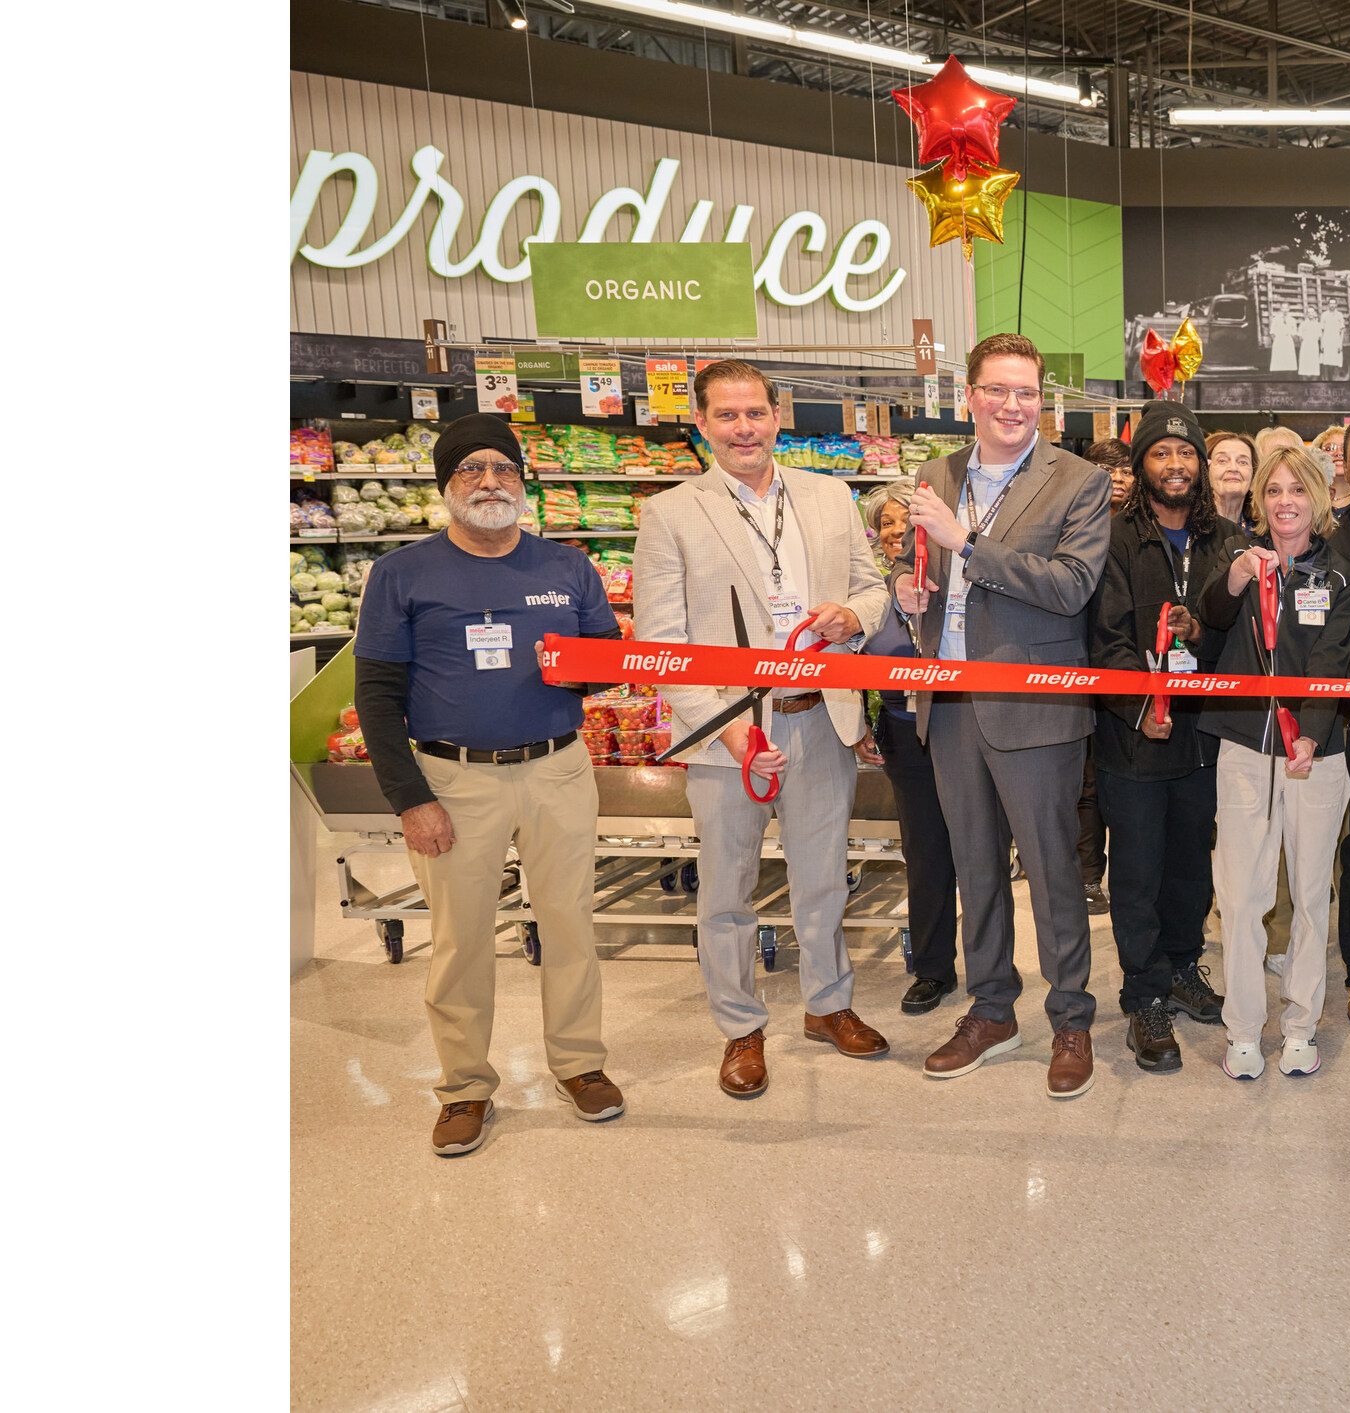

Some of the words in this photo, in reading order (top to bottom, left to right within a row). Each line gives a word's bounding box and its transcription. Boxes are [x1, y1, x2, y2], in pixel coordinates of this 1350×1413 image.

[585, 279, 701, 301] ORGANIC
[426, 333, 433, 345] A
[919, 333, 931, 345] A
[426, 349, 434, 360] 11
[919, 348, 931, 360] 11
[354, 358, 419, 375] PERFECTED
[517, 361, 551, 369] ORGANIC
[655, 362, 678, 371] sale
[525, 591, 570, 608] meijer
[622, 650, 693, 676] meijer
[754, 657, 827, 680] meijer
[888, 664, 962, 685] meijer
[1025, 671, 1100, 688] meijer
[1166, 677, 1240, 691] meijer
